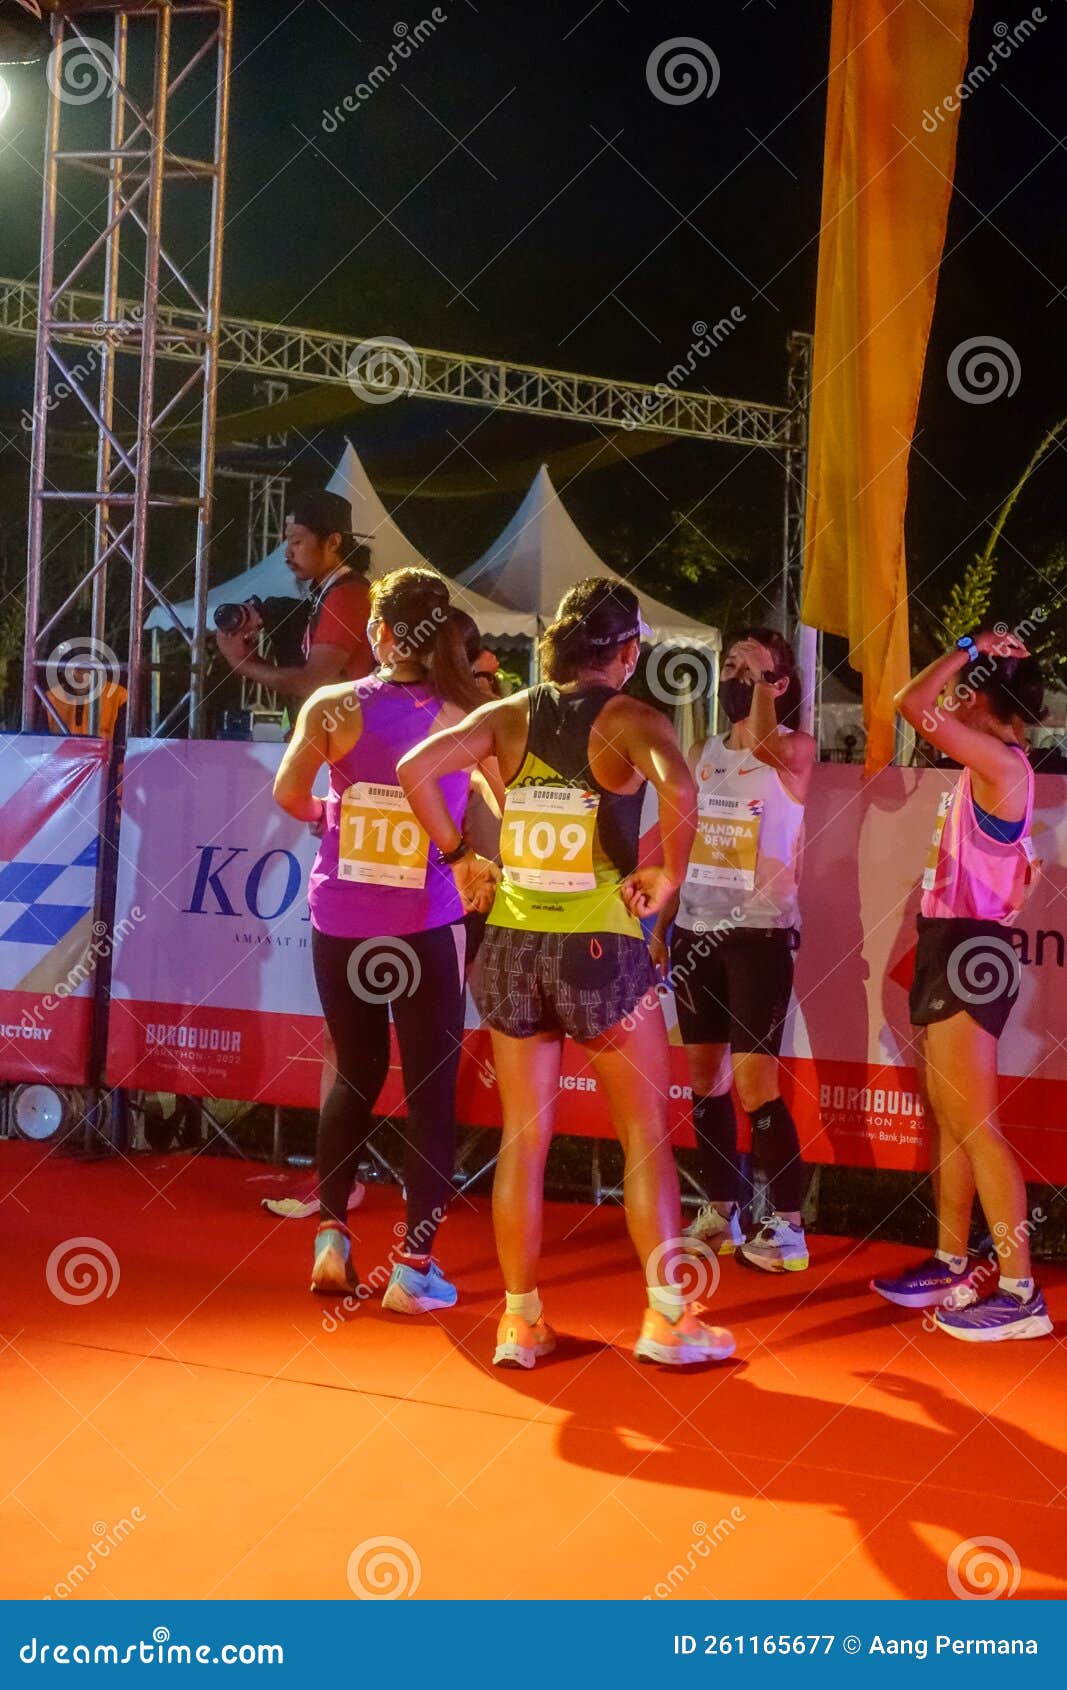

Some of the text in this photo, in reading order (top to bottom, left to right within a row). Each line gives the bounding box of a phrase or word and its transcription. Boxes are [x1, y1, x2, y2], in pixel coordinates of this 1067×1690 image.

[349, 815, 420, 857] 110
[508, 820, 587, 862] 109
[704, 834, 737, 849] DEWI
[181, 845, 312, 922] KO
[1011, 927, 1066, 968] an
[0, 1025, 51, 1041] ICTORY
[146, 1023, 241, 1052] BOROBUDUR
[669, 1085, 693, 1100] OR
[820, 1084, 925, 1117] BOROBUDU
